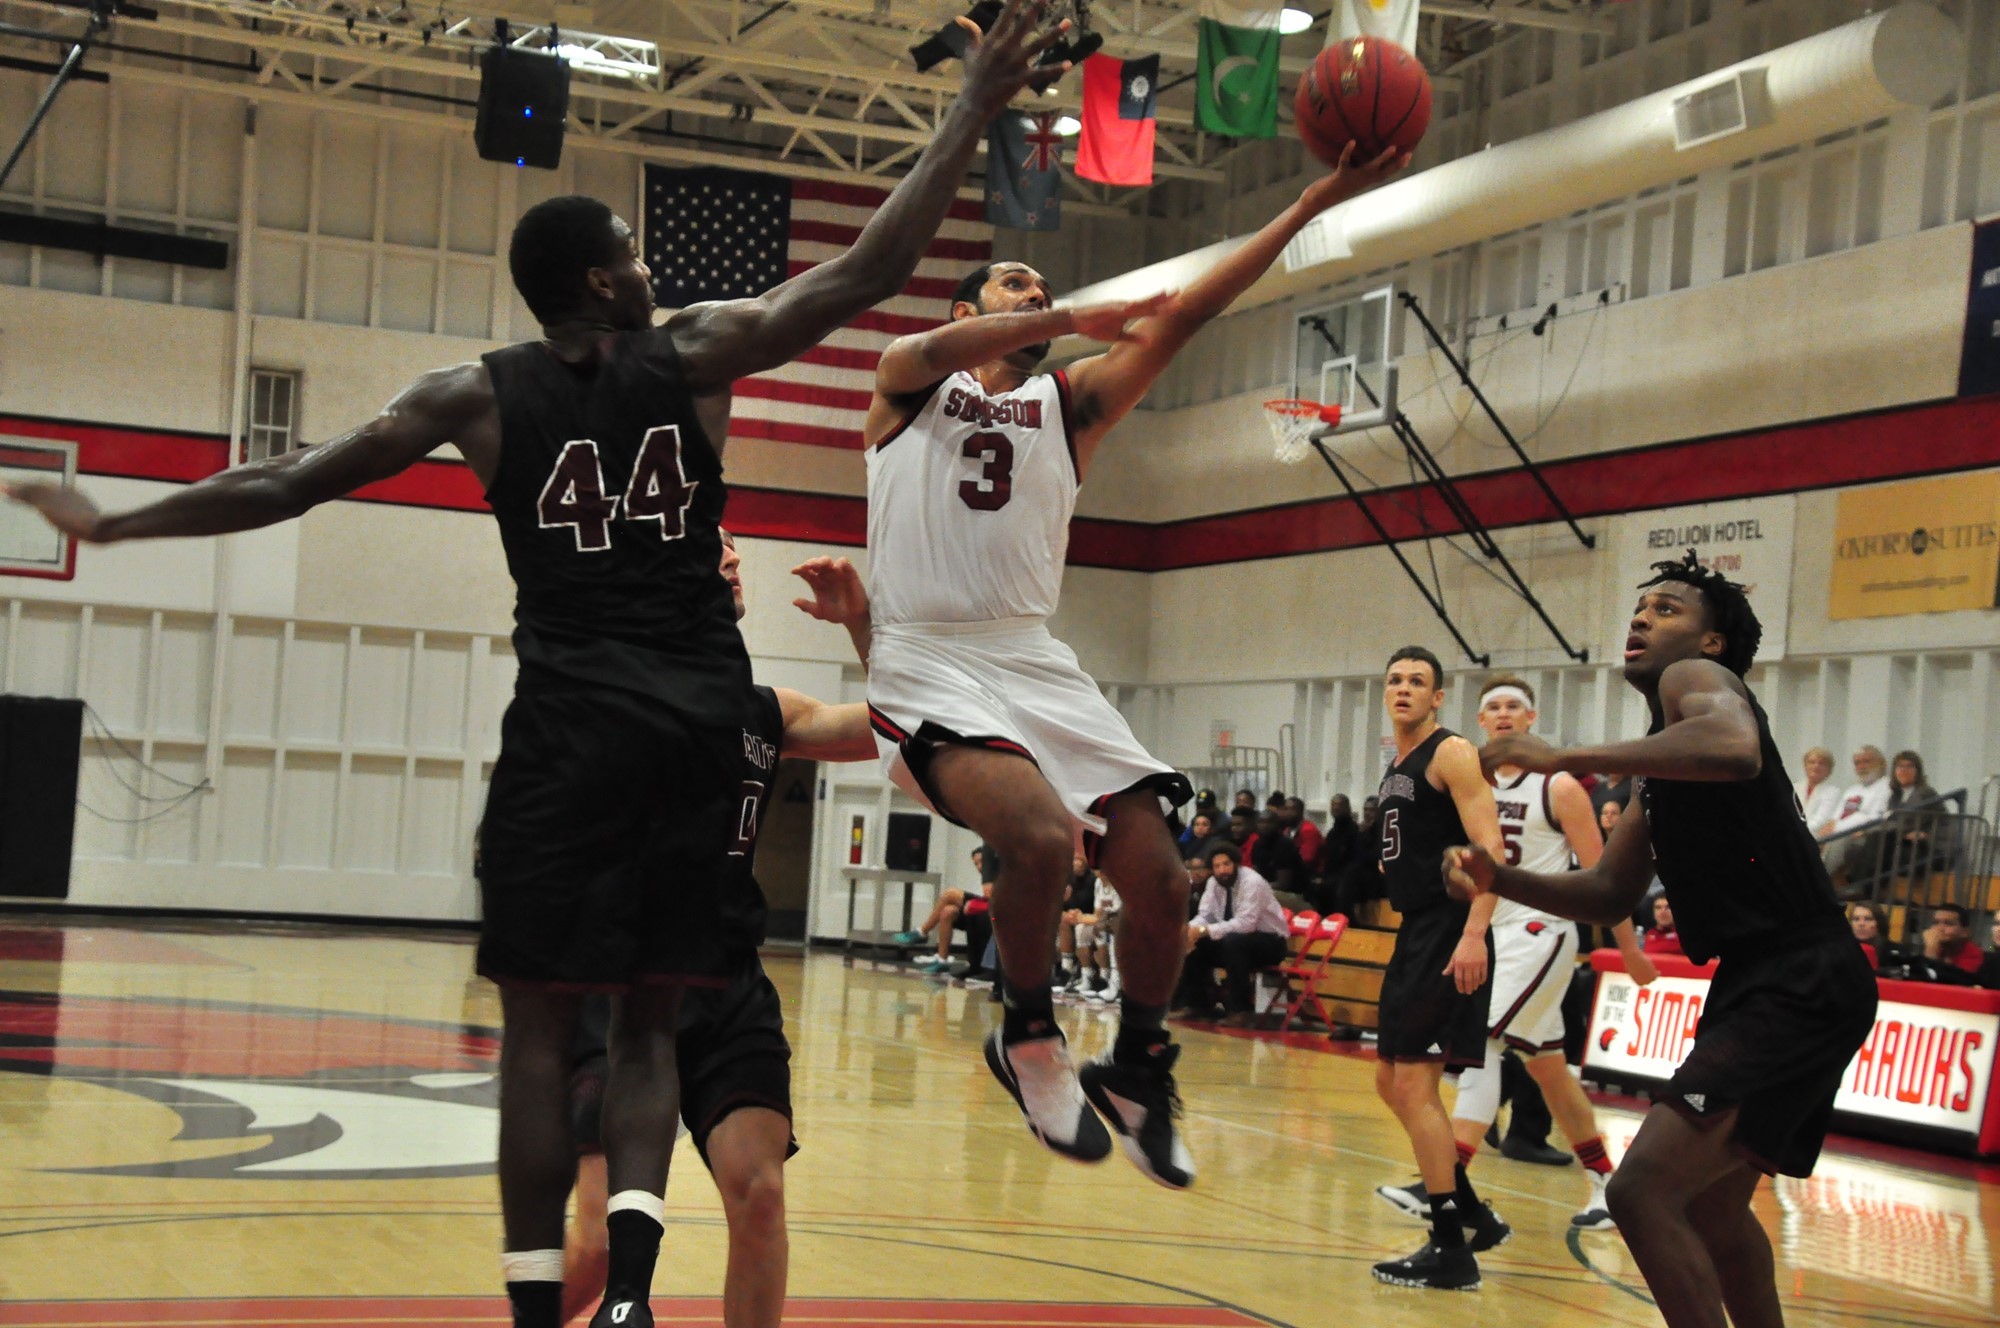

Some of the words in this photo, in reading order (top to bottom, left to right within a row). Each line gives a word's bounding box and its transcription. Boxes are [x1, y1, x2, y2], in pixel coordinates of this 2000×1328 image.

[943, 387, 1043, 429] SIMPSON
[537, 424, 699, 552] 44
[958, 432, 1014, 511] 3
[1648, 529, 1676, 548] RED
[1678, 524, 1711, 546] LION
[1714, 519, 1763, 541] HOTEL
[1382, 808, 1401, 861] 5
[1495, 800, 1529, 820] PSON
[1626, 988, 1702, 1063] SIMP
[1852, 1020, 1983, 1113] HAWKS
